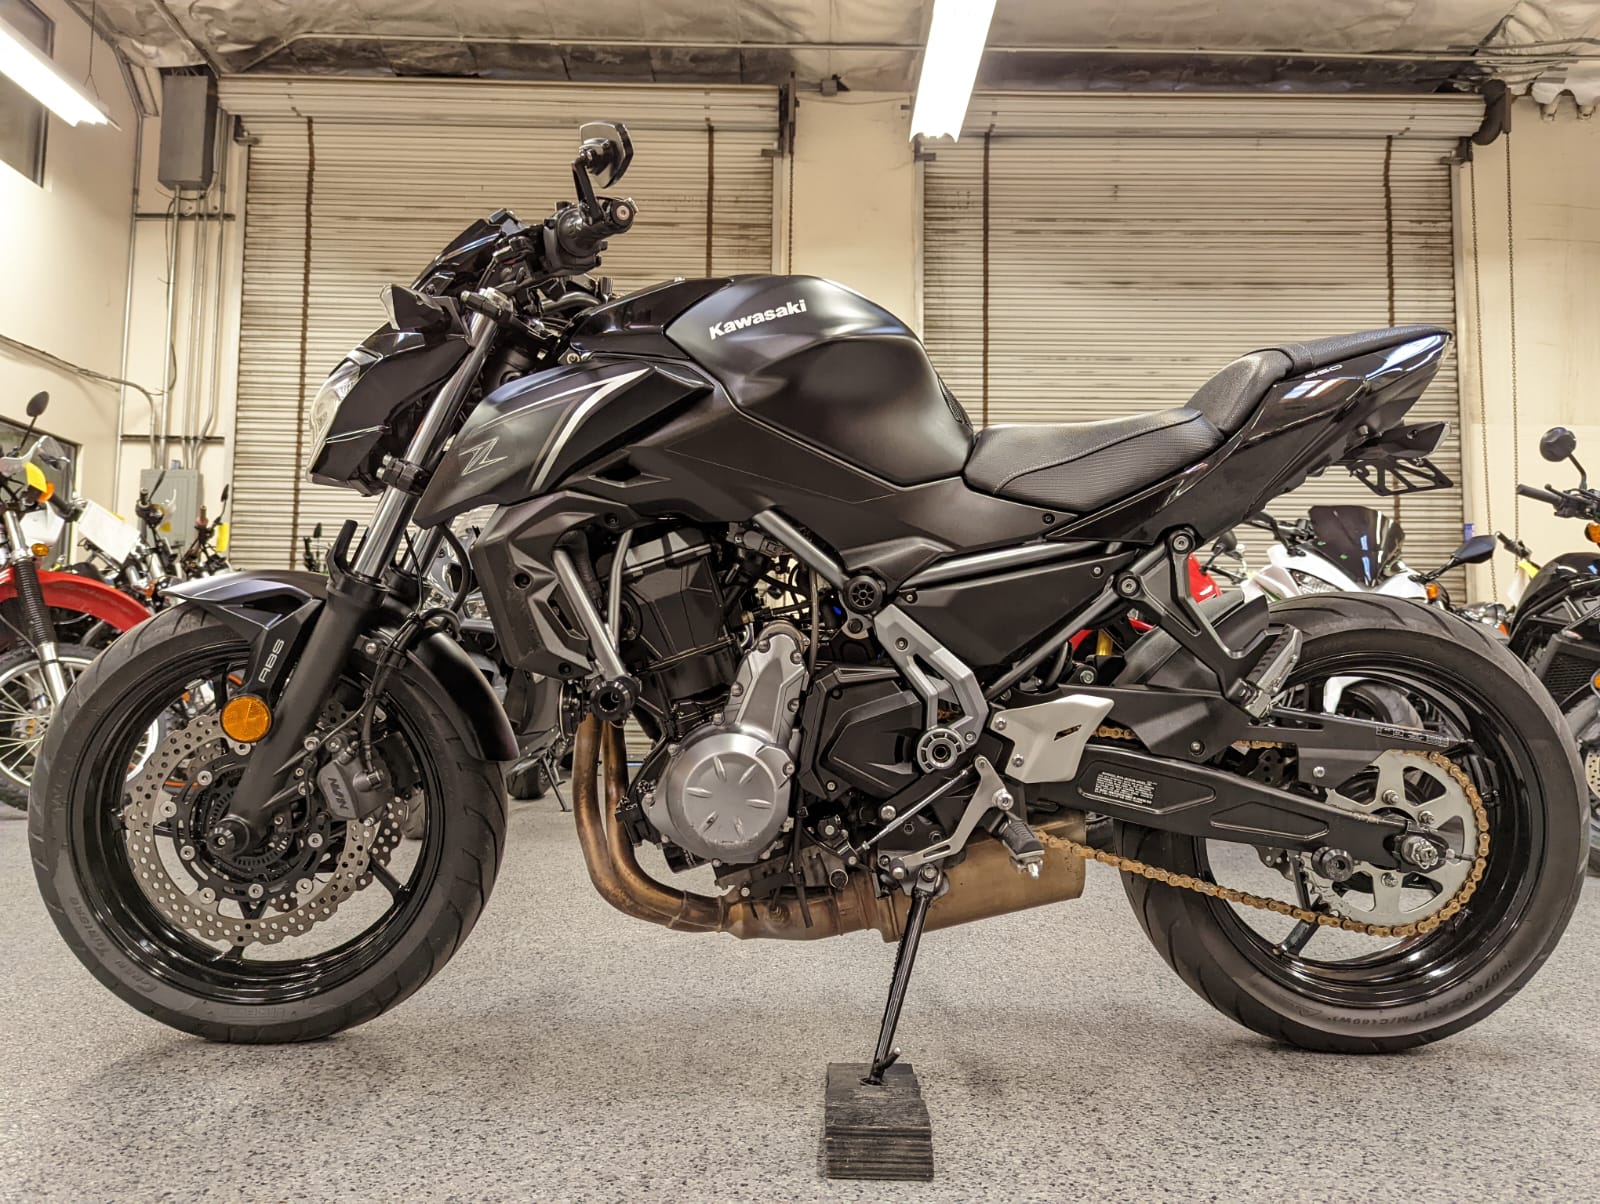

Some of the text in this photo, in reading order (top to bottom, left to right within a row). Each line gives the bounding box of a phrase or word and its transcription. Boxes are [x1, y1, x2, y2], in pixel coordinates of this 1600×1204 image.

[708, 299, 807, 340] Kawasaki
[458, 436, 508, 477] Z
[258, 638, 285, 683] ABS
